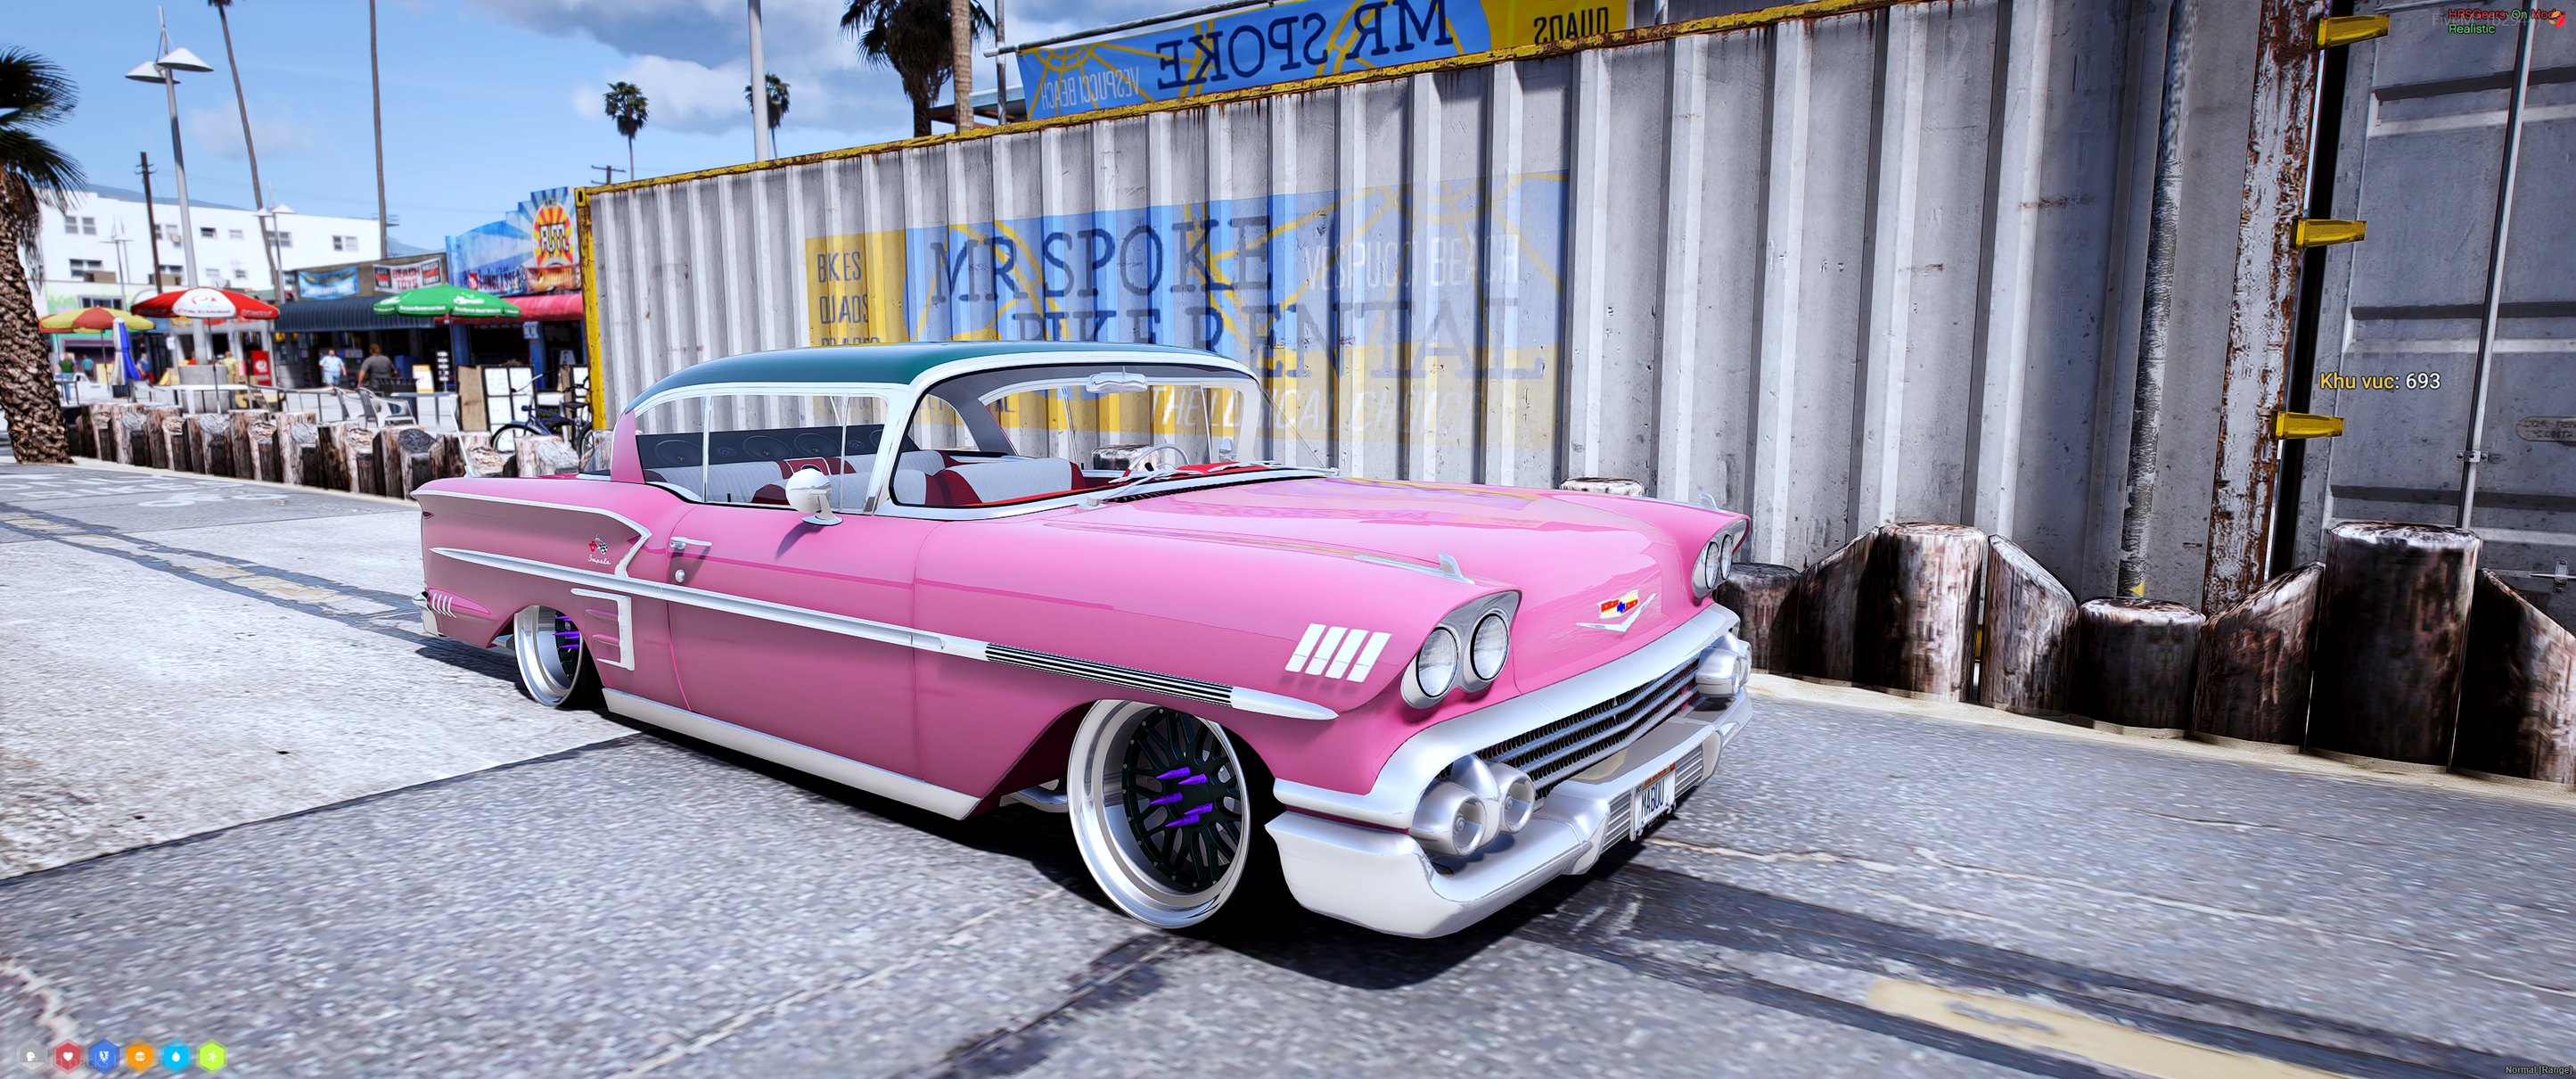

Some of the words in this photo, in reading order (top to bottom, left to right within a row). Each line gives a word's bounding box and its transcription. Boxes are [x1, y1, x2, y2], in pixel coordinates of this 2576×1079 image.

[1041, 215, 1270, 297] SPOKE
[392, 267, 421, 279] BEACH
[817, 251, 861, 283] BKES
[397, 278, 418, 290] TOYS
[15, 481, 244, 499] BIKES
